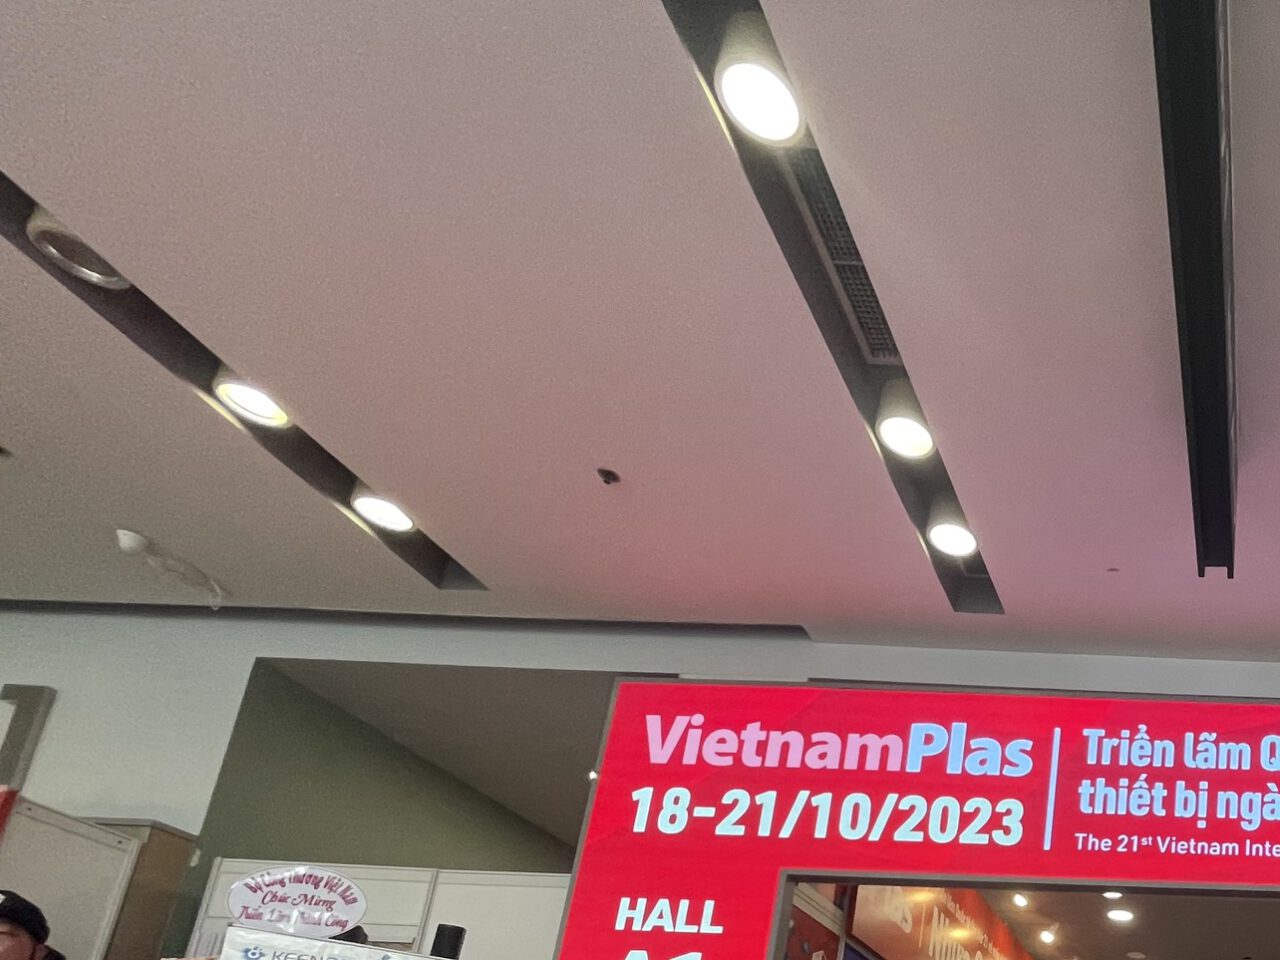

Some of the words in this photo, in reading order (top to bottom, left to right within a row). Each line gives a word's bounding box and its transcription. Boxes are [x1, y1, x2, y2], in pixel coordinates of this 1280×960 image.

[645, 714, 1033, 777] VietnamPlas
[1082, 724, 1175, 769] Triển
[1183, 731, 1251, 771] lãm
[631, 786, 1024, 846] 18-21/10/2023
[1078, 773, 1167, 816] thiết
[1174, 781, 1208, 828] bị
[1074, 833, 1112, 851] The
[1157, 836, 1239, 857] Vietnam
[614, 897, 723, 934] HALL
